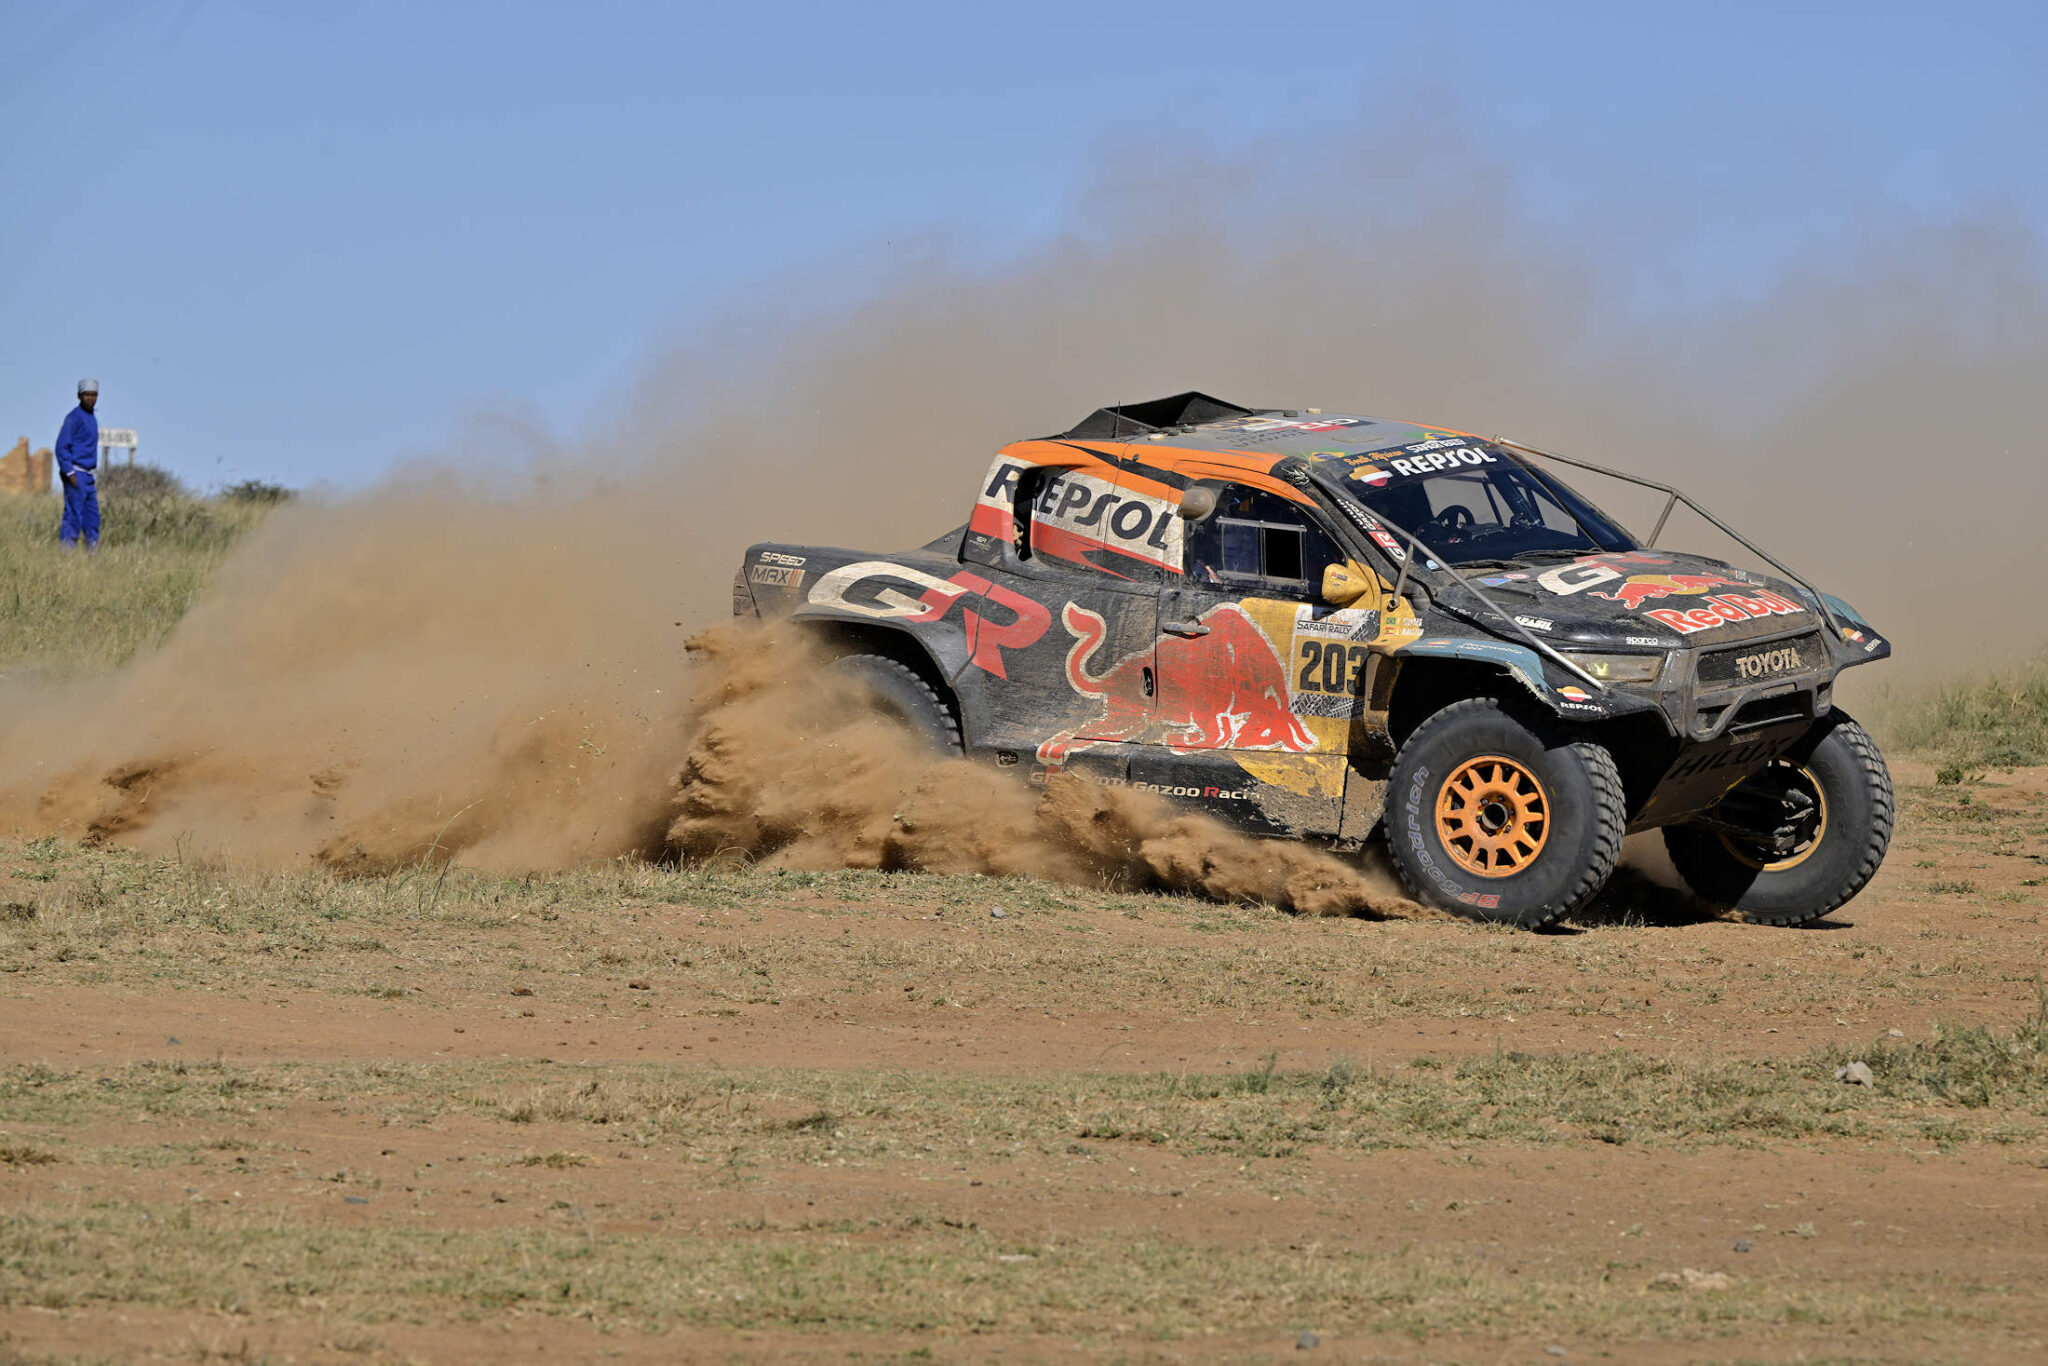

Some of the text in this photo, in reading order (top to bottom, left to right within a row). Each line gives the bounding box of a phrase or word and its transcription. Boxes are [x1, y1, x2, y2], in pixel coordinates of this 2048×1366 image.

[1391, 447, 1498, 477] REPSOL
[985, 463, 1174, 550] REPSOL
[760, 551, 806, 567] SPEED
[752, 567, 792, 584] MAX
[808, 561, 1052, 680] GR
[1297, 621, 1352, 634] SAFARI RALLY
[1626, 636, 1659, 646] sparco
[1300, 641, 1369, 696] 203
[1735, 647, 1802, 679] TOYOTA
[1405, 766, 1501, 910] BFGoodrich
